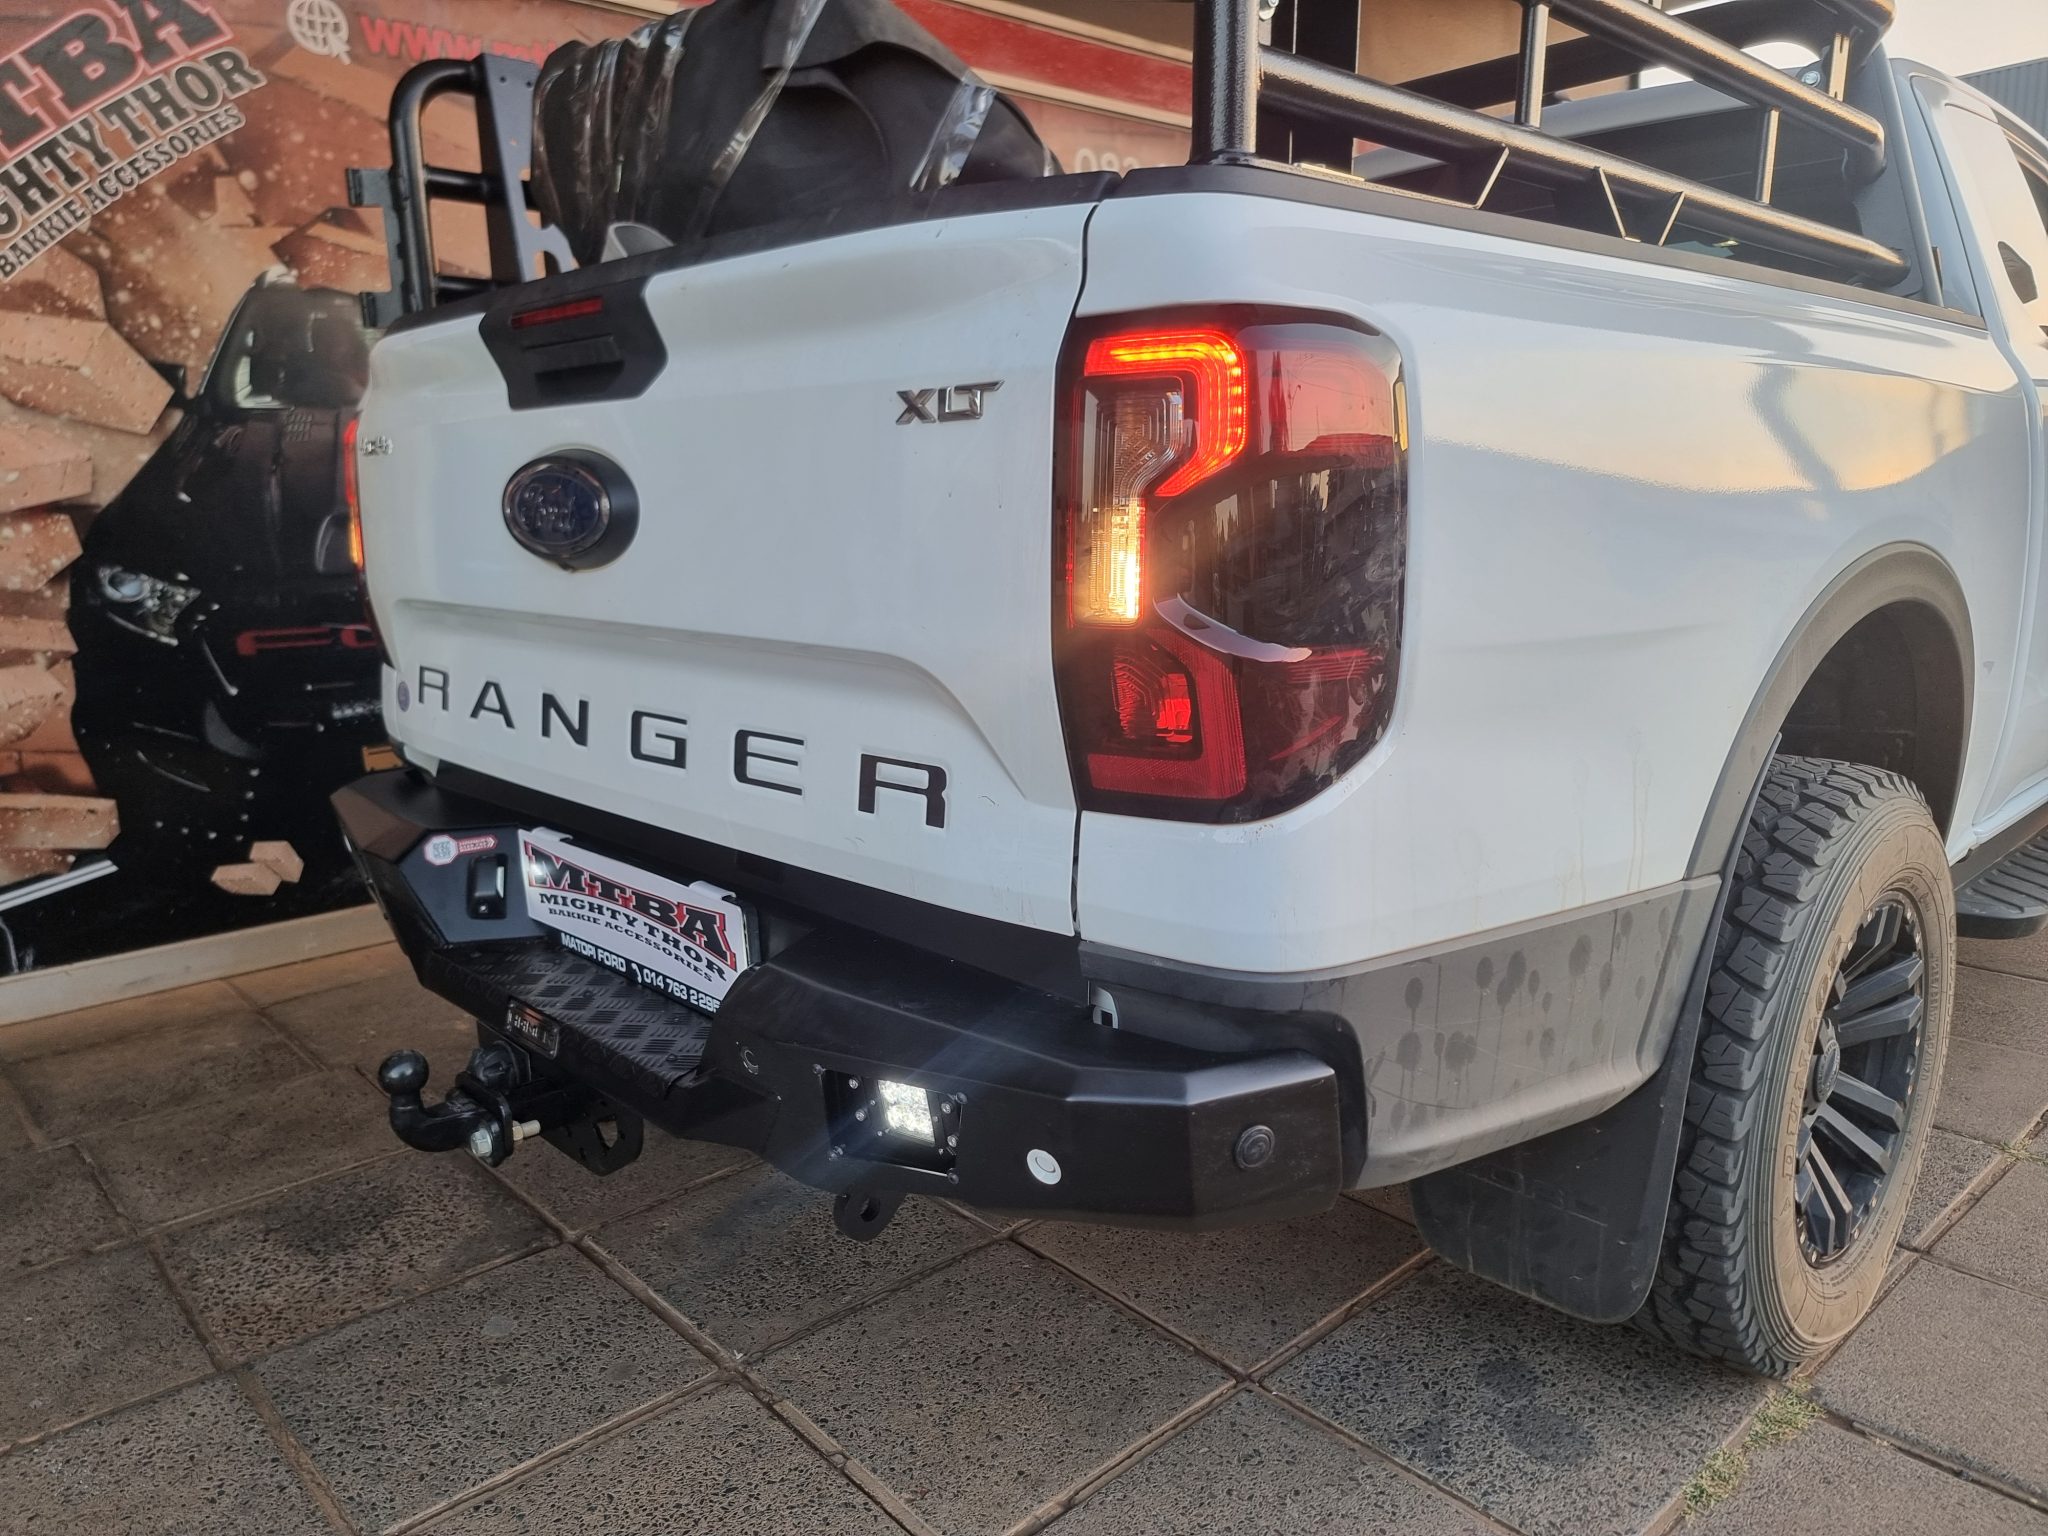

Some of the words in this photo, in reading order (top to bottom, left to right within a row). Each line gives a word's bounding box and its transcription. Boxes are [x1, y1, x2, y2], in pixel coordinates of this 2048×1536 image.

[98, 49, 265, 148] THOR
[0, 197, 89, 279] BAKKIE
[82, 103, 243, 211] ACCESSORIES
[895, 379, 1005, 425] XLT
[418, 665, 947, 829] RANGER
[525, 841, 737, 972] MTBA
[539, 893, 639, 928] MIGHTY
[643, 921, 727, 981] THOR
[548, 908, 601, 925] BAKKIE
[604, 921, 713, 982] ACCESSORIES
[598, 948, 627, 973] FORD
[643, 968, 664, 990] 014
[666, 978, 688, 1000] 763
